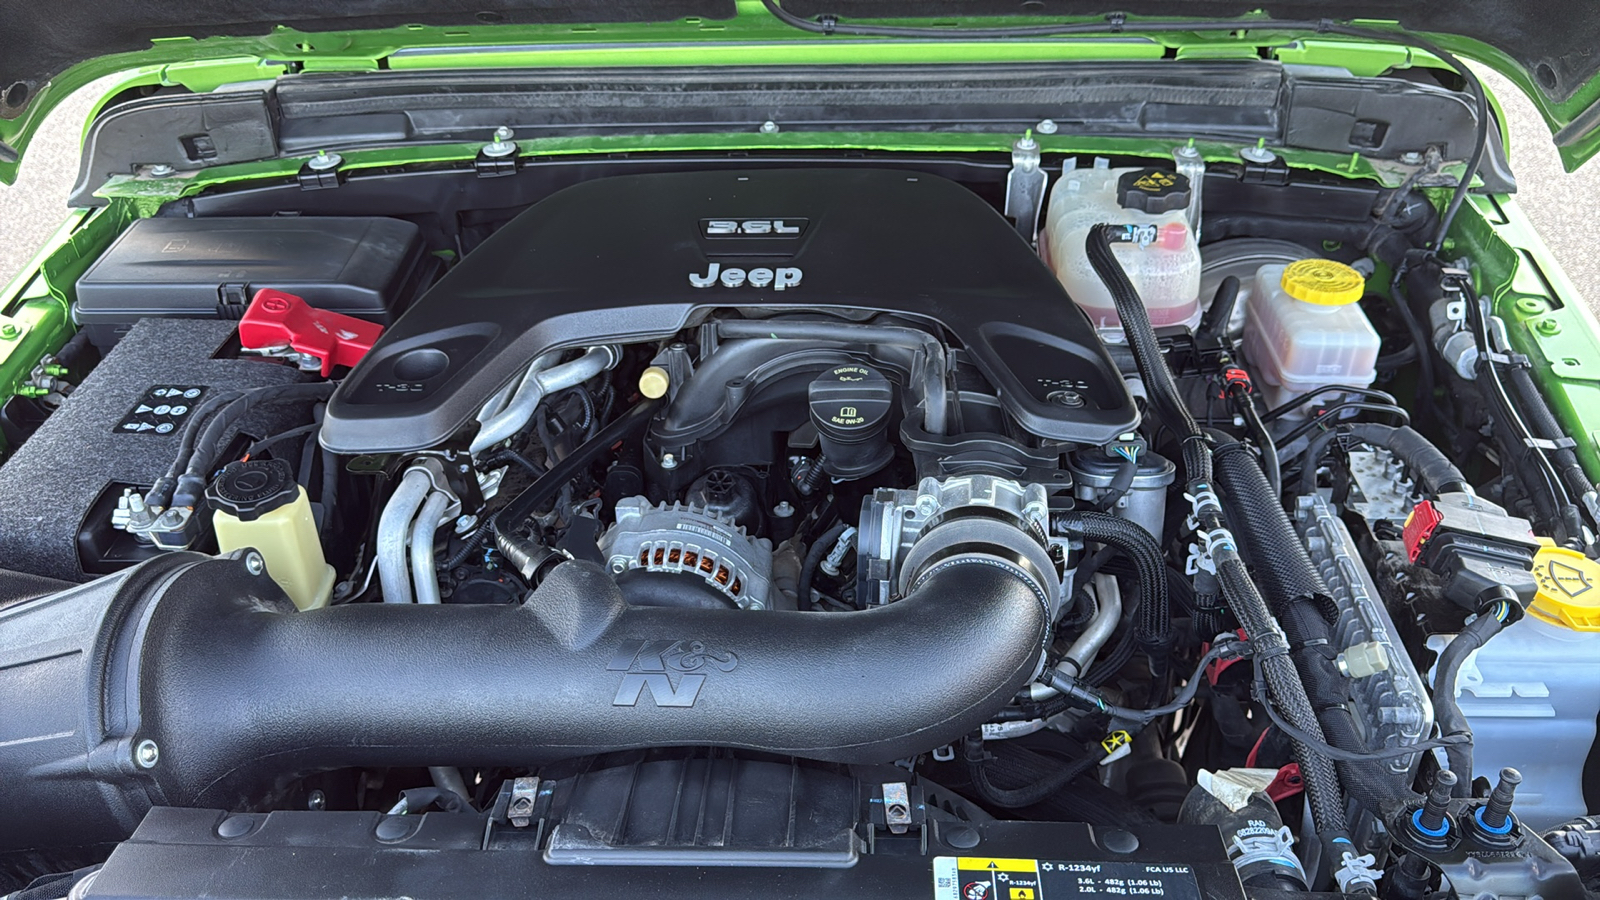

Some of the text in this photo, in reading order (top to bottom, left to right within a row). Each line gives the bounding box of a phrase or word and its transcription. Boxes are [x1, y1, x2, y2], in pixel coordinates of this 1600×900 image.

[707, 220, 800, 234] 3.6L
[688, 262, 804, 291] Jeep
[833, 367, 869, 376] ENGINE OIL
[831, 416, 865, 425] SAE 0W-20
[1247, 819, 1267, 828] RAD
[1058, 863, 1101, 874] R-1234yf
[1077, 877, 1095, 885] 3.6L
[1104, 878, 1125, 887] 482g
[1127, 878, 1148, 887] (1.06
[1149, 880, 1163, 888] Lb)
[1078, 885, 1097, 893] 2.0L
[1106, 886, 1127, 895] 482g
[1129, 887, 1150, 895] (1.06
[1151, 888, 1164, 896] Lb)
